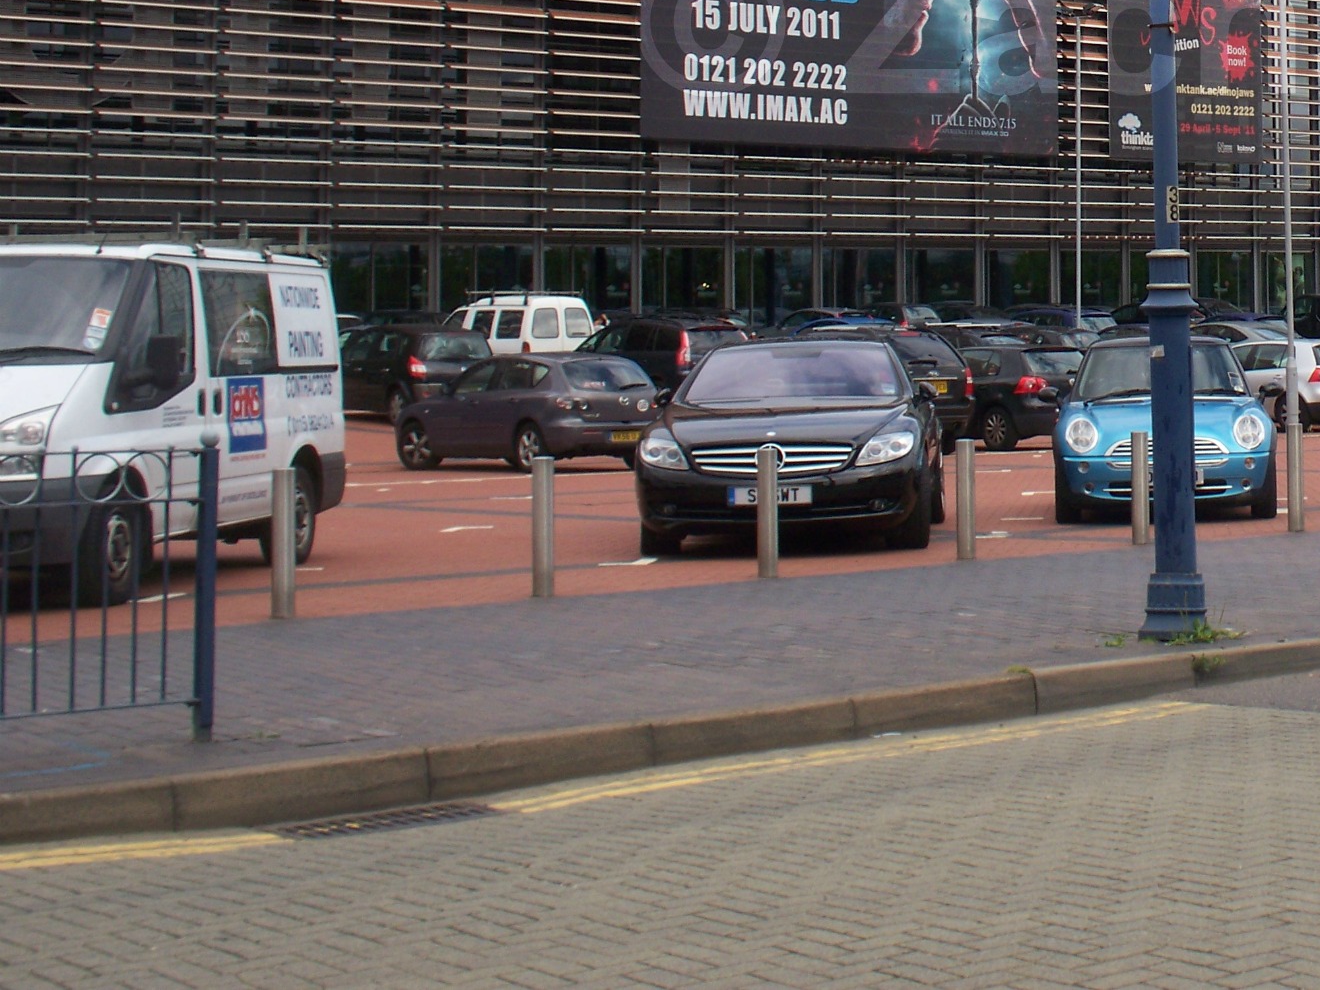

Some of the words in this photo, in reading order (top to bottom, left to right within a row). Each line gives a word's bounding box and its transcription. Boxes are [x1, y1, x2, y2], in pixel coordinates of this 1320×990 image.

[728, 1, 781, 35] JULY
[787, 7, 840, 40] 2011
[1226, 44, 1248, 56] Book
[684, 53, 737, 84] 0121
[743, 58, 786, 87] 202
[793, 61, 848, 91] 2222
[1228, 57, 1247, 68] now!
[683, 89, 848, 125] WWW.IMAX.AC
[1191, 102, 1213, 115] 0121
[1214, 104, 1232, 116] 202
[1233, 105, 1255, 117] 2222
[931, 113, 943, 125] IT
[945, 114, 965, 127] ALL
[967, 115, 997, 128] ENDS
[999, 117, 1017, 130] 7.15
[1180, 122, 1191, 133] 29
[1193, 123, 1211, 135] April
[1222, 124, 1241, 136] Sept
[1120, 130, 1154, 146] thinkta
[279, 285, 321, 309] NATIONWIDE
[287, 331, 324, 358] PAINTING
[286, 374, 333, 398] CONTRACTORS
